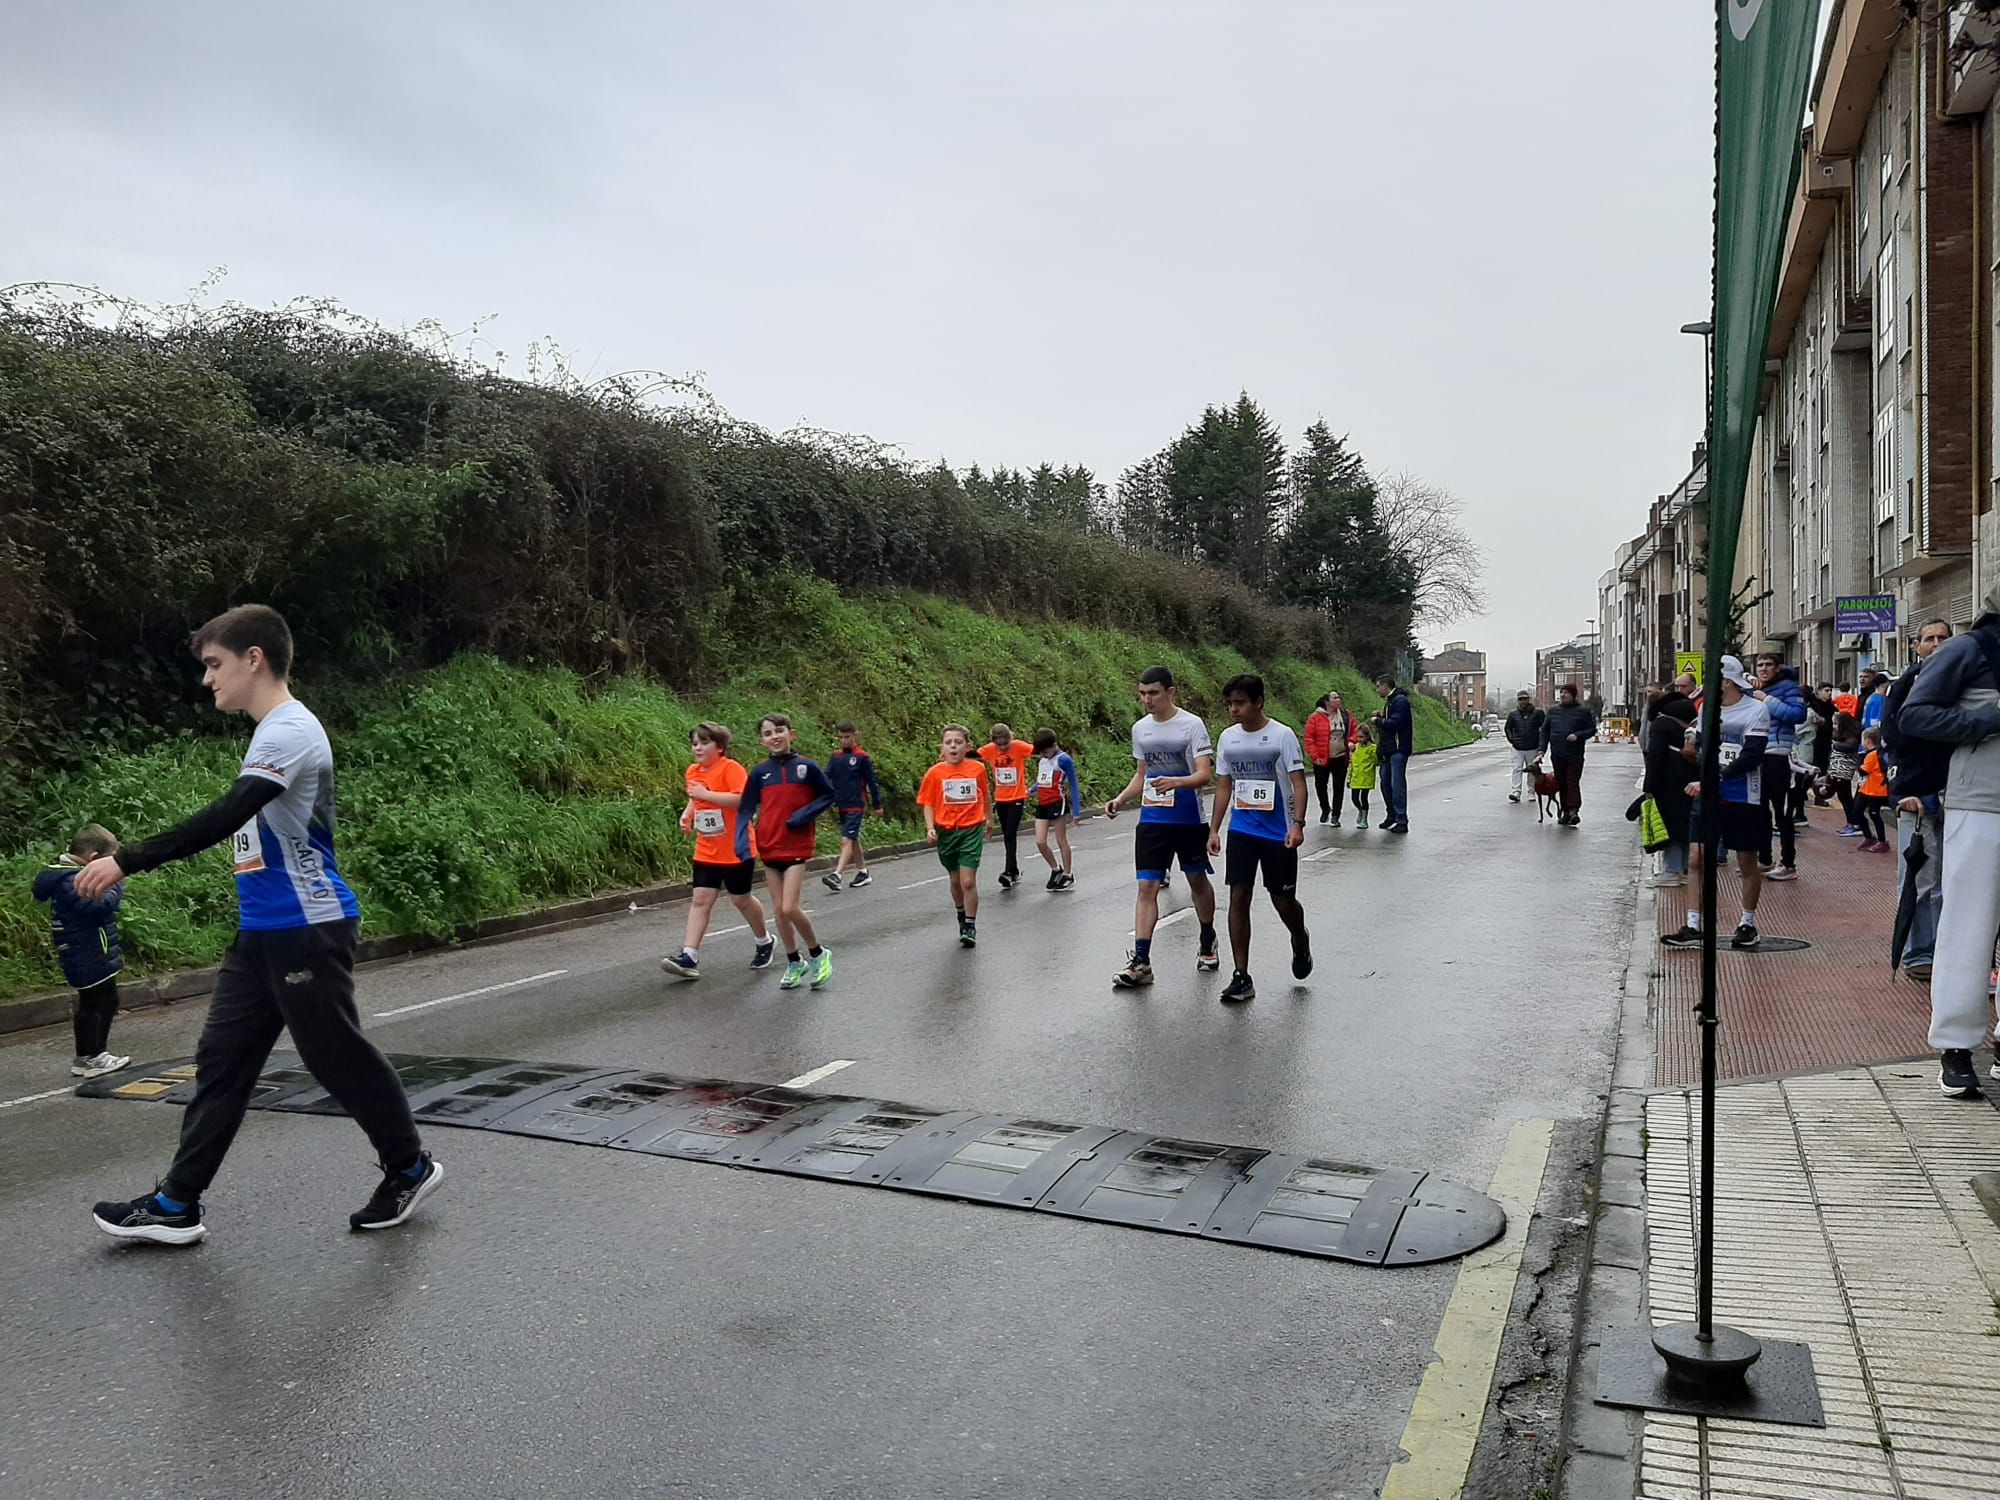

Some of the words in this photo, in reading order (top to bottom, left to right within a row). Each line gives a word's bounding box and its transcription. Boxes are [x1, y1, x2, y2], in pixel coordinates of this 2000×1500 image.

[1838, 597, 1894, 610] PARQUESOL
[1724, 750, 1736, 760] 83
[960, 785, 971, 795] 39
[1253, 788, 1267, 800] 85
[704, 817, 717, 827] 38
